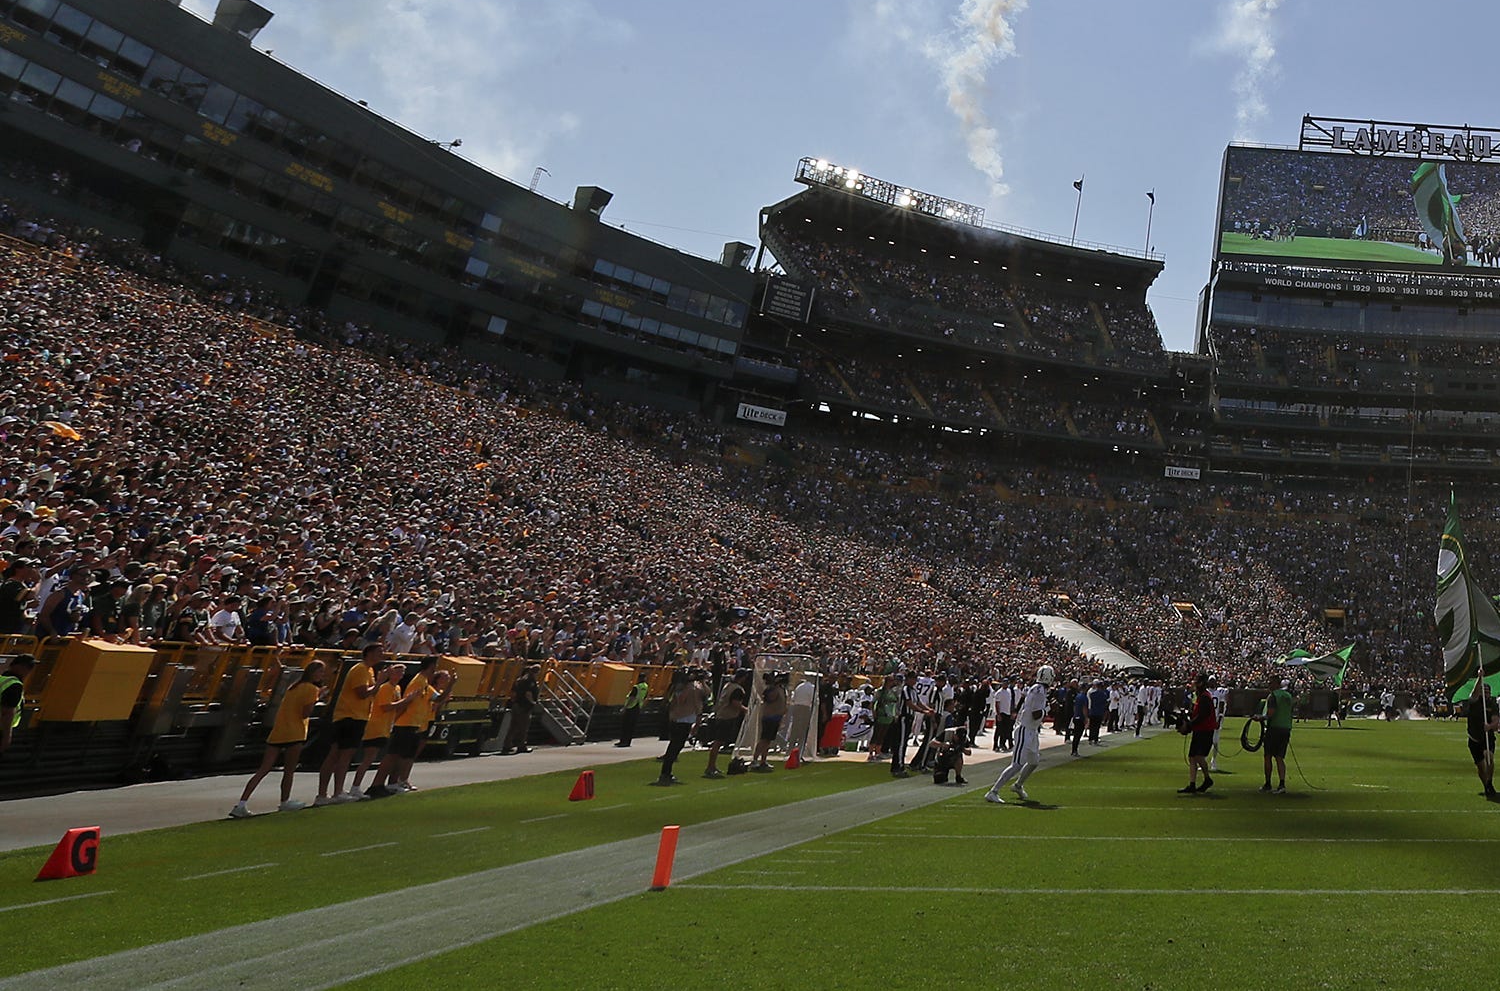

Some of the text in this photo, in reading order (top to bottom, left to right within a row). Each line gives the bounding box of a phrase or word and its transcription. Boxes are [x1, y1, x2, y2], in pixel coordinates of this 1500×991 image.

[1333, 127, 1491, 158] LAMBEAU
[1265, 277, 1292, 288] WORLD
[1294, 280, 1342, 291] CHAMPIONS
[1353, 284, 1370, 292] 1929
[1402, 287, 1419, 295] 1931
[1425, 288, 1444, 296] 1936
[743, 407, 777, 421] Lite DECK
[916, 682, 931, 696] 97
[1352, 702, 1365, 713] G
[71, 830, 97, 873] G
